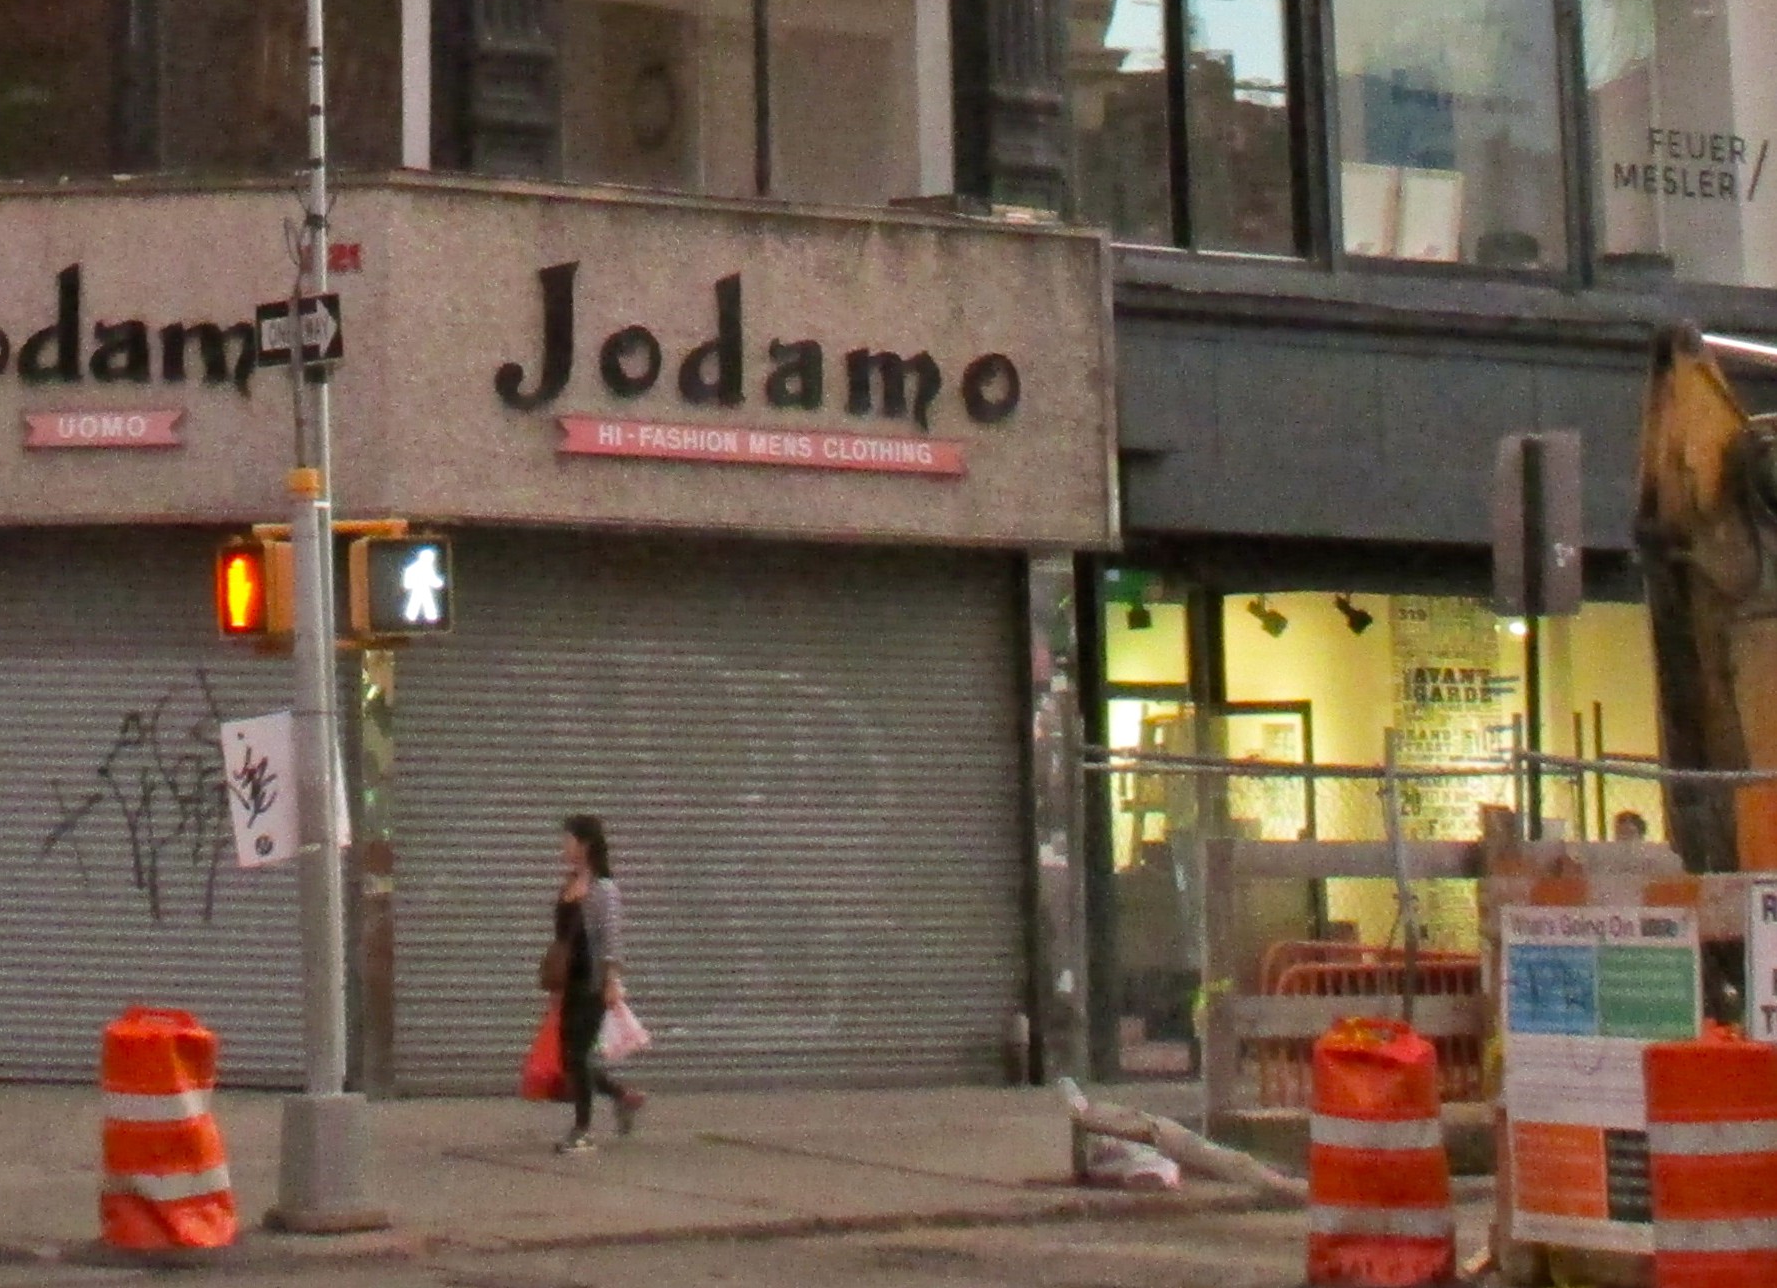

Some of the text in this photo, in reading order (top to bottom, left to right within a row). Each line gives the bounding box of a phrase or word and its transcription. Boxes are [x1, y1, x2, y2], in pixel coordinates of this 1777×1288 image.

[1649, 127, 1746, 164] FEUER
[1613, 162, 1737, 199] MESLER
[495, 260, 1020, 429] Jodamo
[57, 415, 146, 438] UOMO
[749, 432, 812, 458] MENS
[824, 438, 933, 465] CLOTHING
